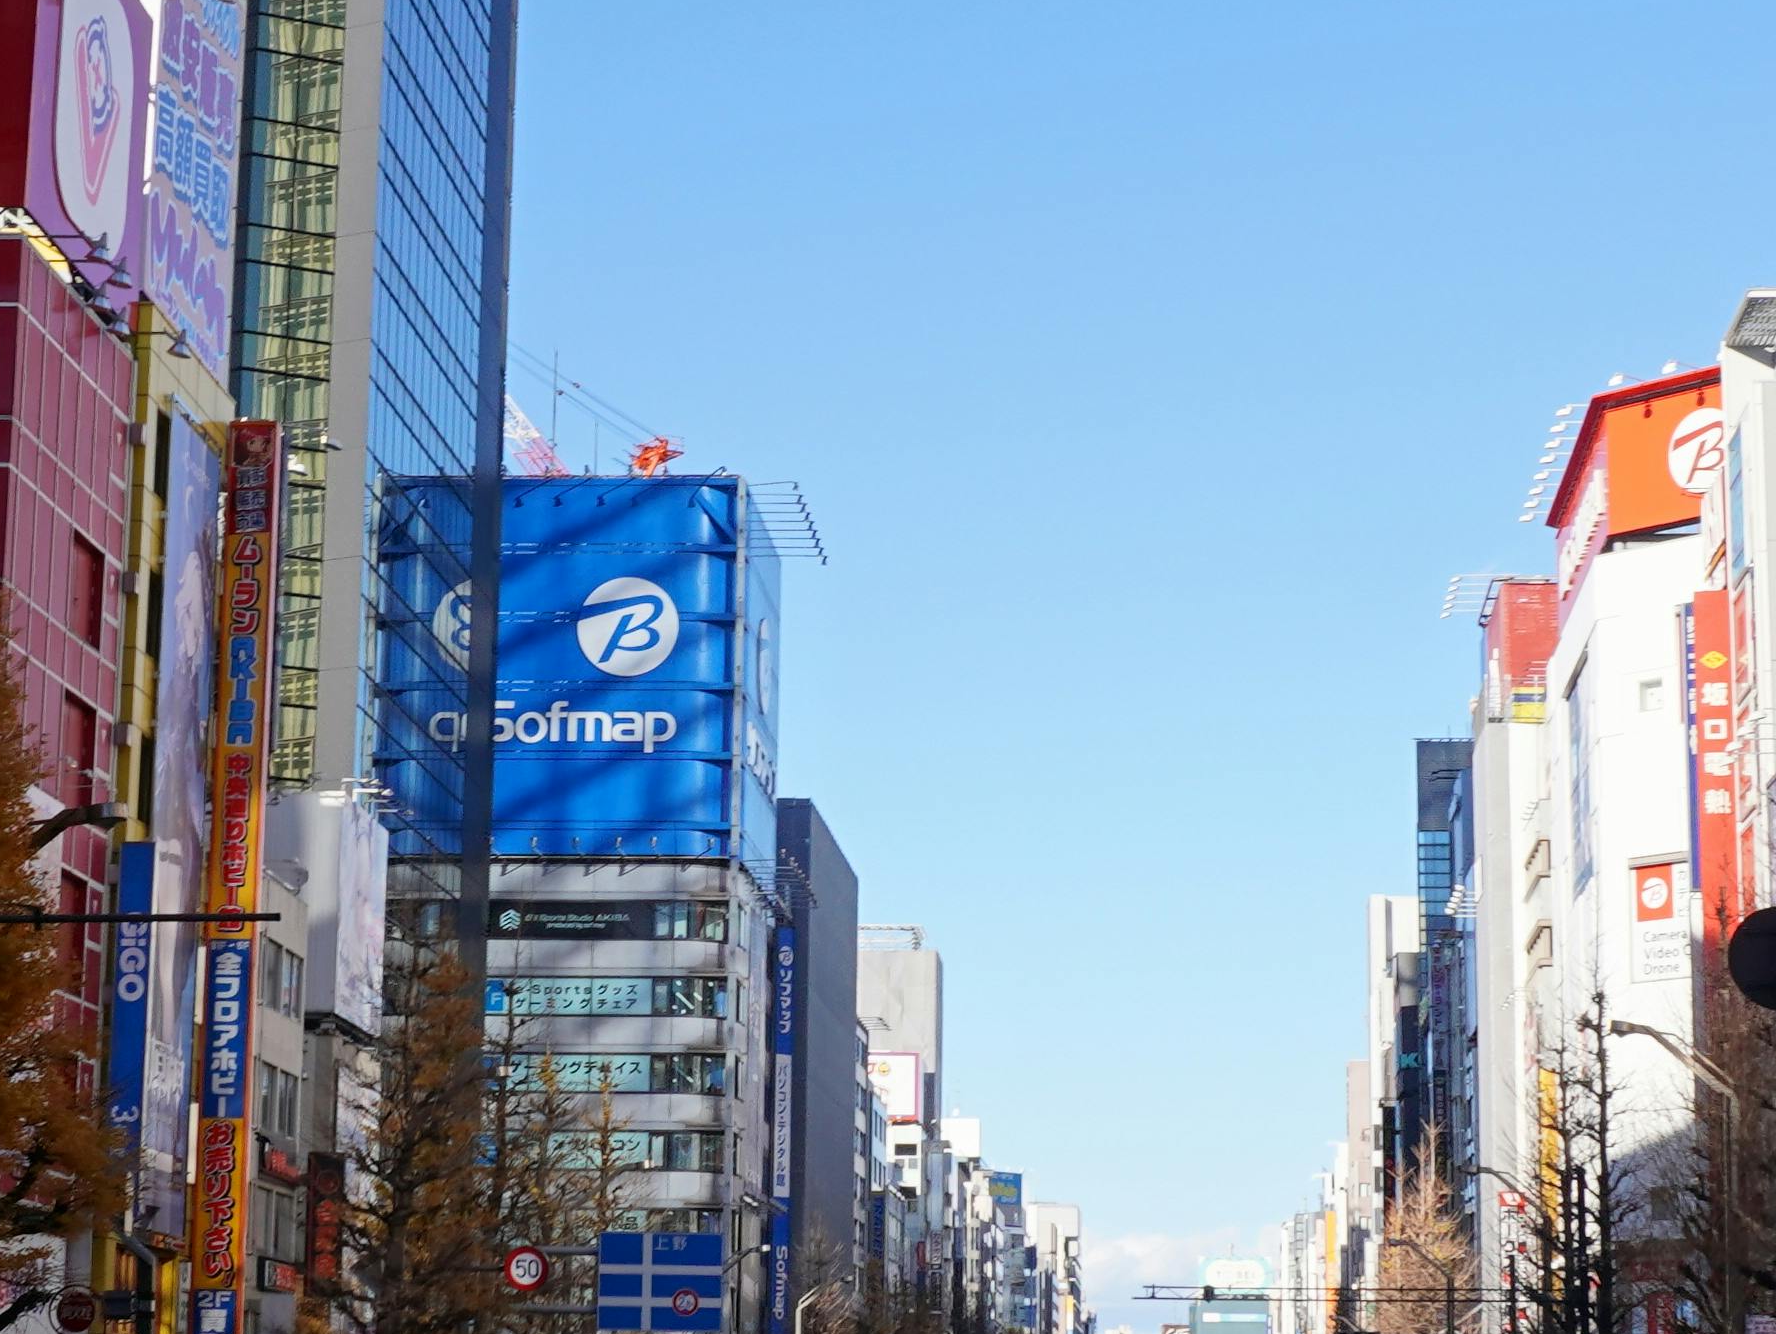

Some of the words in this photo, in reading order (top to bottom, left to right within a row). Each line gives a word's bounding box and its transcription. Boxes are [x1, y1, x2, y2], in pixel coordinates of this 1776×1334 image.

[230, 535, 261, 635] ムーラン
[1701, 682, 1733, 815] 坂口電熱
[1642, 930, 1688, 944] Camera
[1642, 945, 1680, 958] Video
[1643, 961, 1681, 975] Drone
[514, 998, 639, 1011] ゲーミングチェア
[779, 969, 794, 1035] ソフマップ
[211, 952, 243, 1117] 全フロアホビー
[515, 1259, 540, 1279] 50
[773, 1243, 789, 1320] Sofmap
[196, 1289, 233, 1309] 2F
